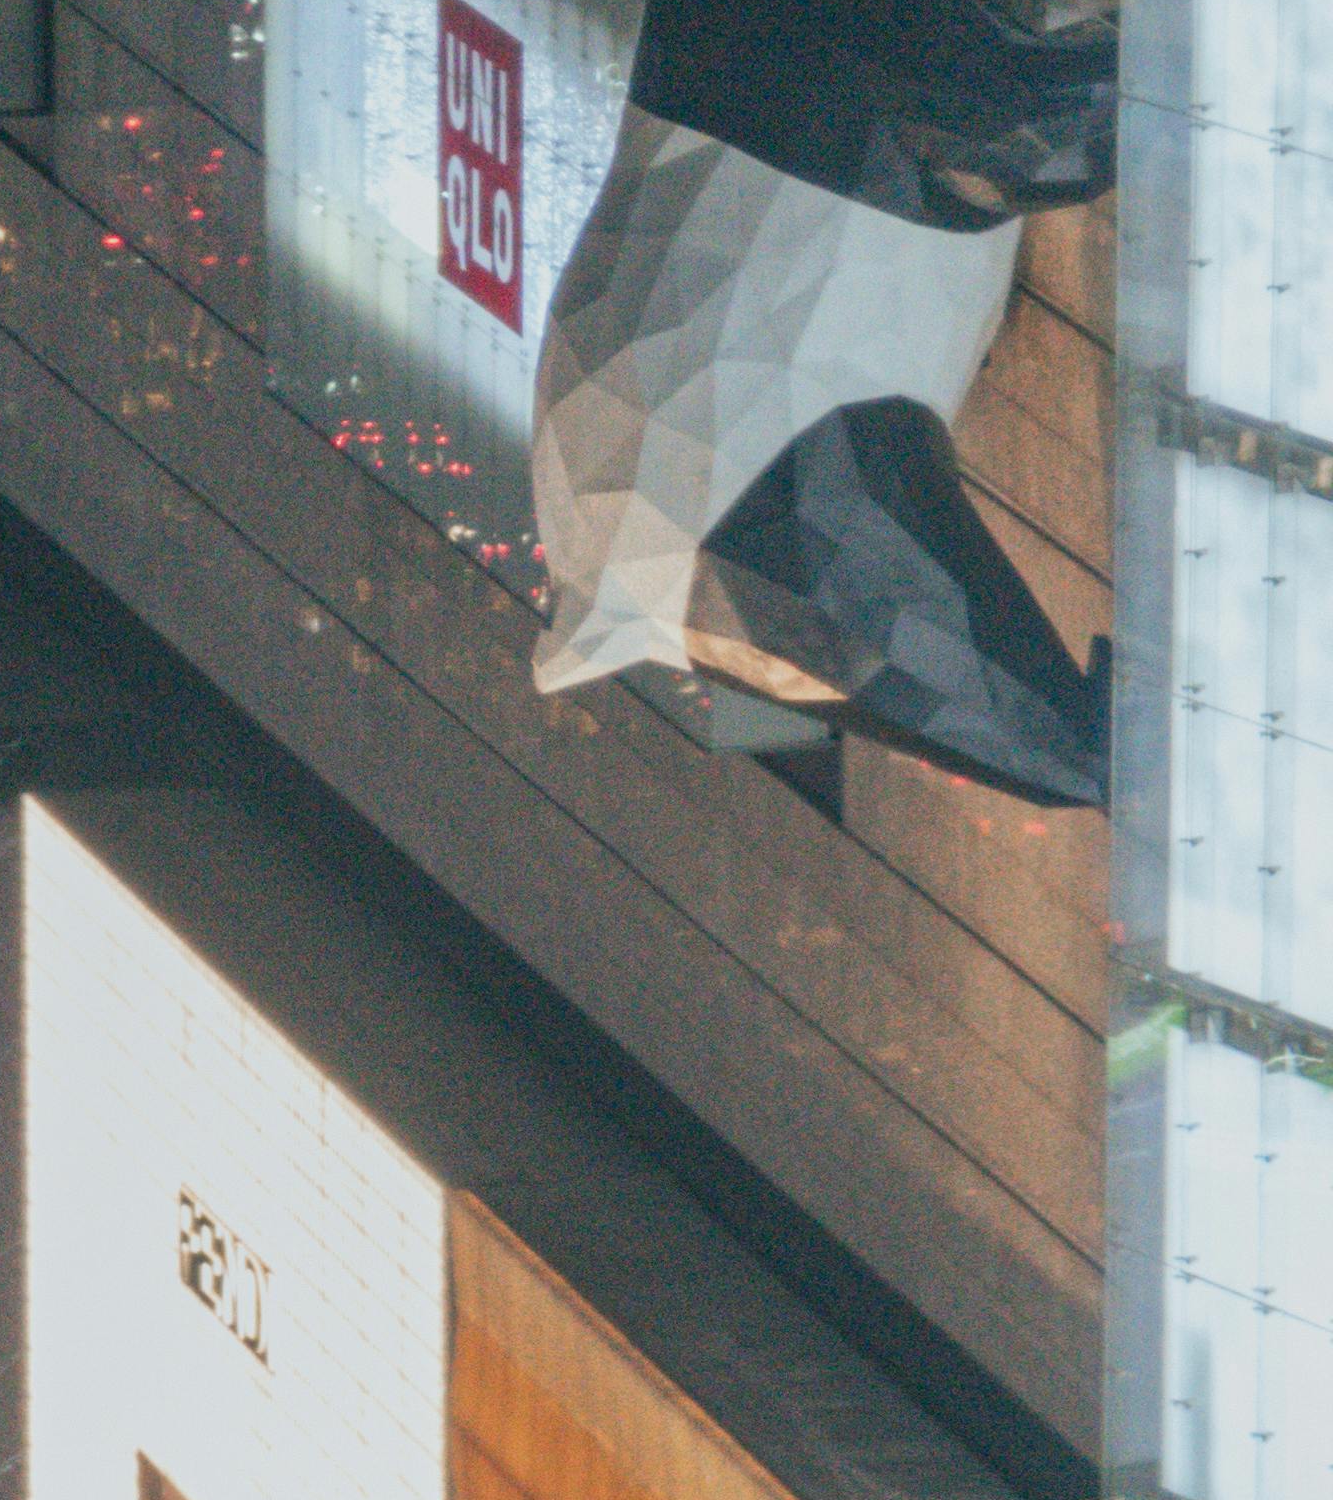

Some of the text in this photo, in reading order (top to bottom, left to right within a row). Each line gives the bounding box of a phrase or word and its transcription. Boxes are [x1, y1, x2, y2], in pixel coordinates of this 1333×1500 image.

[445, 31, 508, 165] UNI
[446, 154, 514, 284] QLO
[178, 1182, 275, 1375] FENDI
